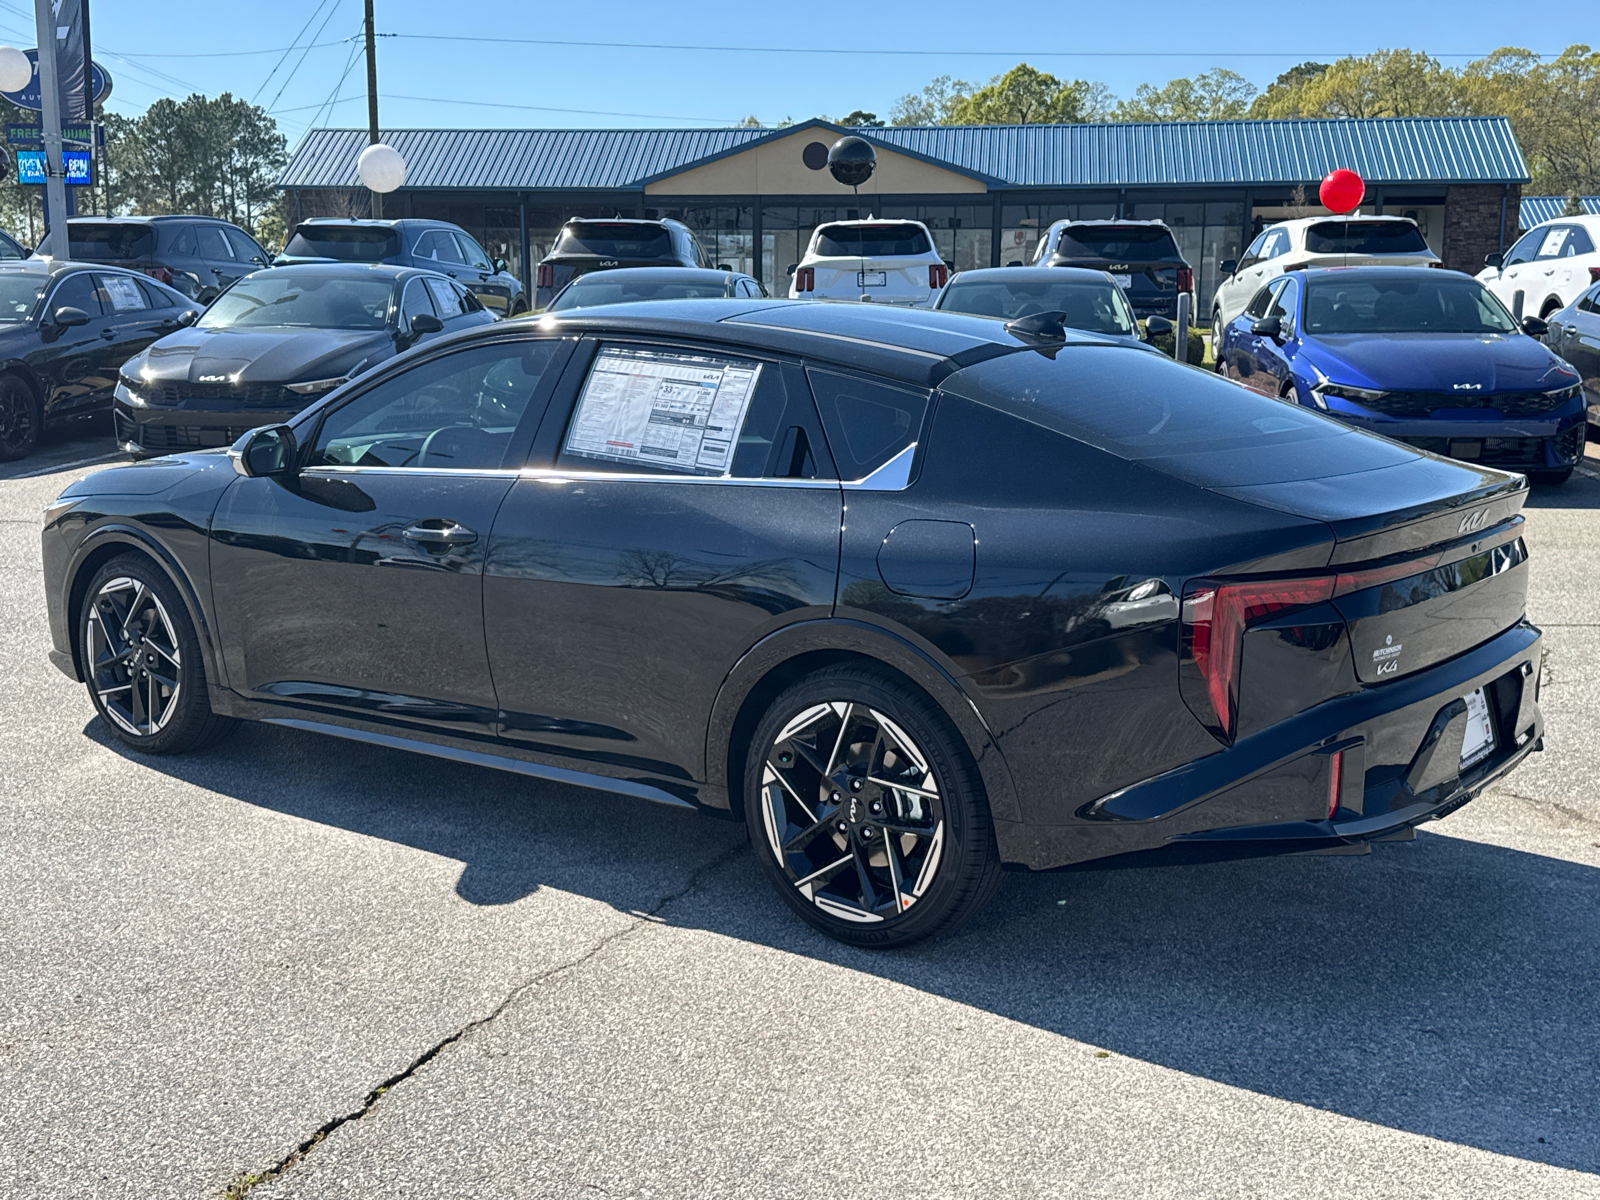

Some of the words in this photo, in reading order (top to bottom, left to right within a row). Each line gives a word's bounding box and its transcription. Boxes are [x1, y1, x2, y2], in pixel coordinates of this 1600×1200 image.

[10, 128, 38, 139] FREE
[1453, 383, 1483, 391] KIA
[1458, 508, 1490, 534] KIA
[1377, 659, 1398, 676] K4
[849, 798, 857, 824] KIA
